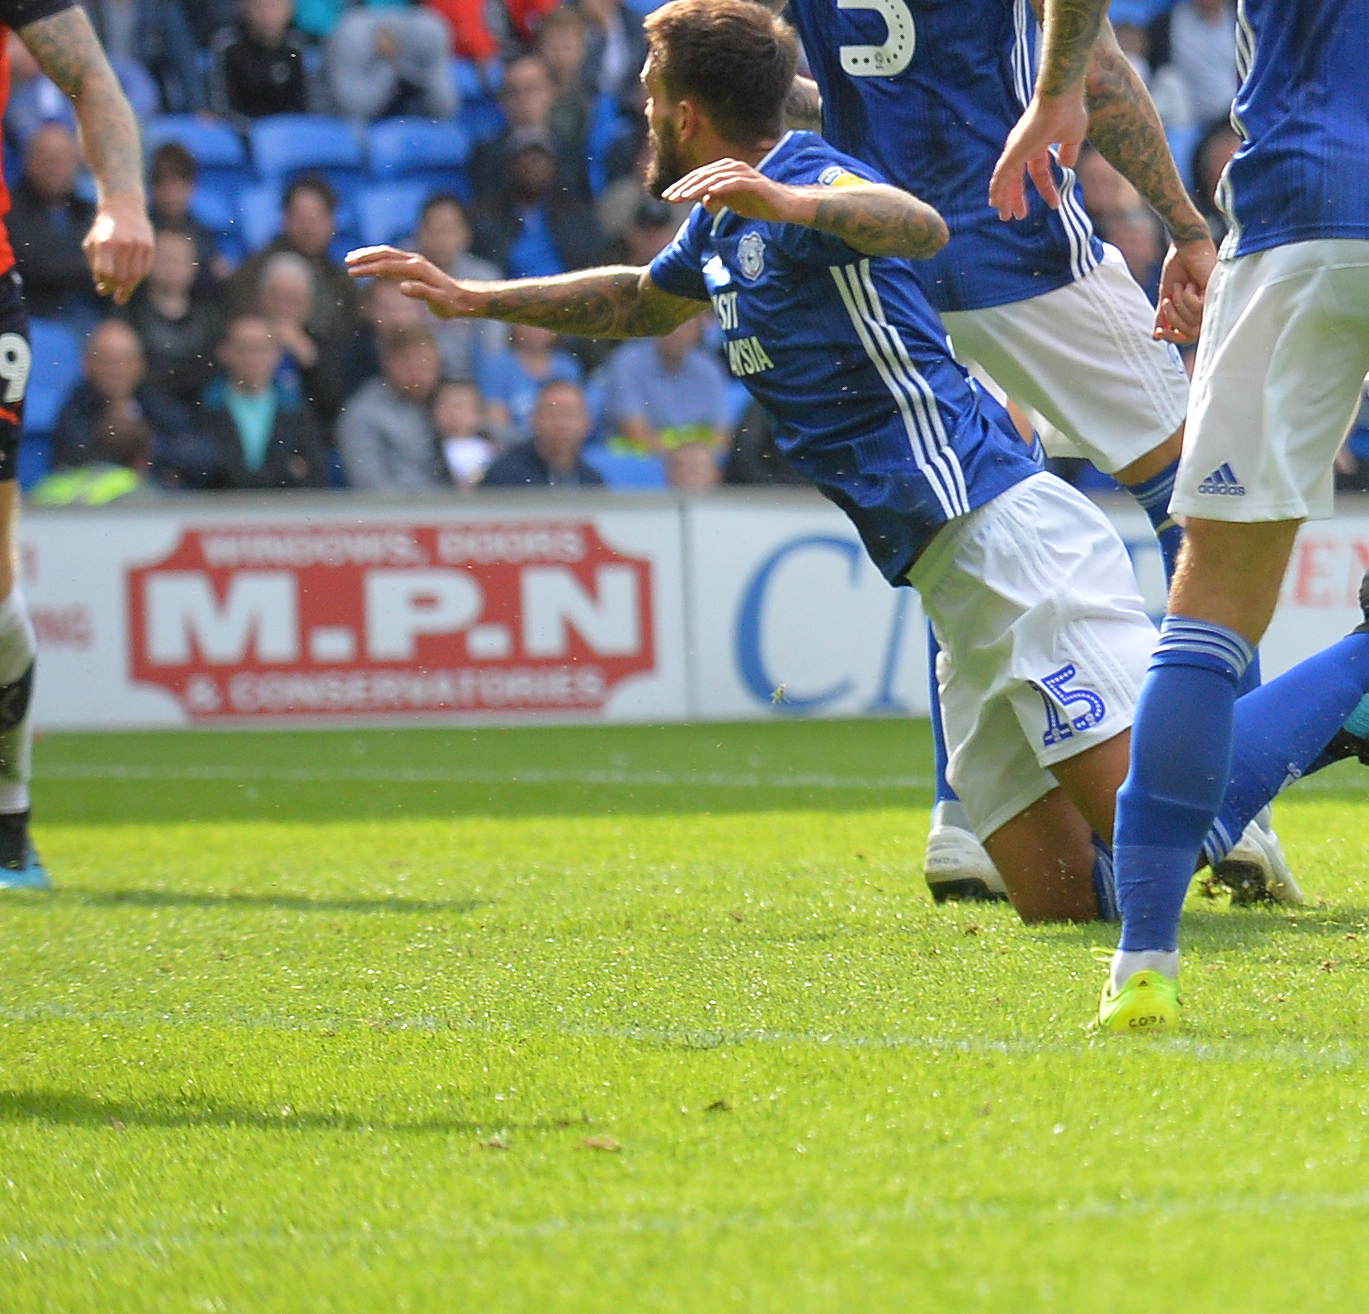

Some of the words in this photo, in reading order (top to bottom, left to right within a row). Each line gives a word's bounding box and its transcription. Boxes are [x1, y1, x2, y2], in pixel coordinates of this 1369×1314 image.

[1197, 484, 1246, 497] adidas
[144, 564, 643, 666] M.P.N
[228, 665, 606, 712] CONSERVATORIES
[1027, 662, 1107, 747] 15
